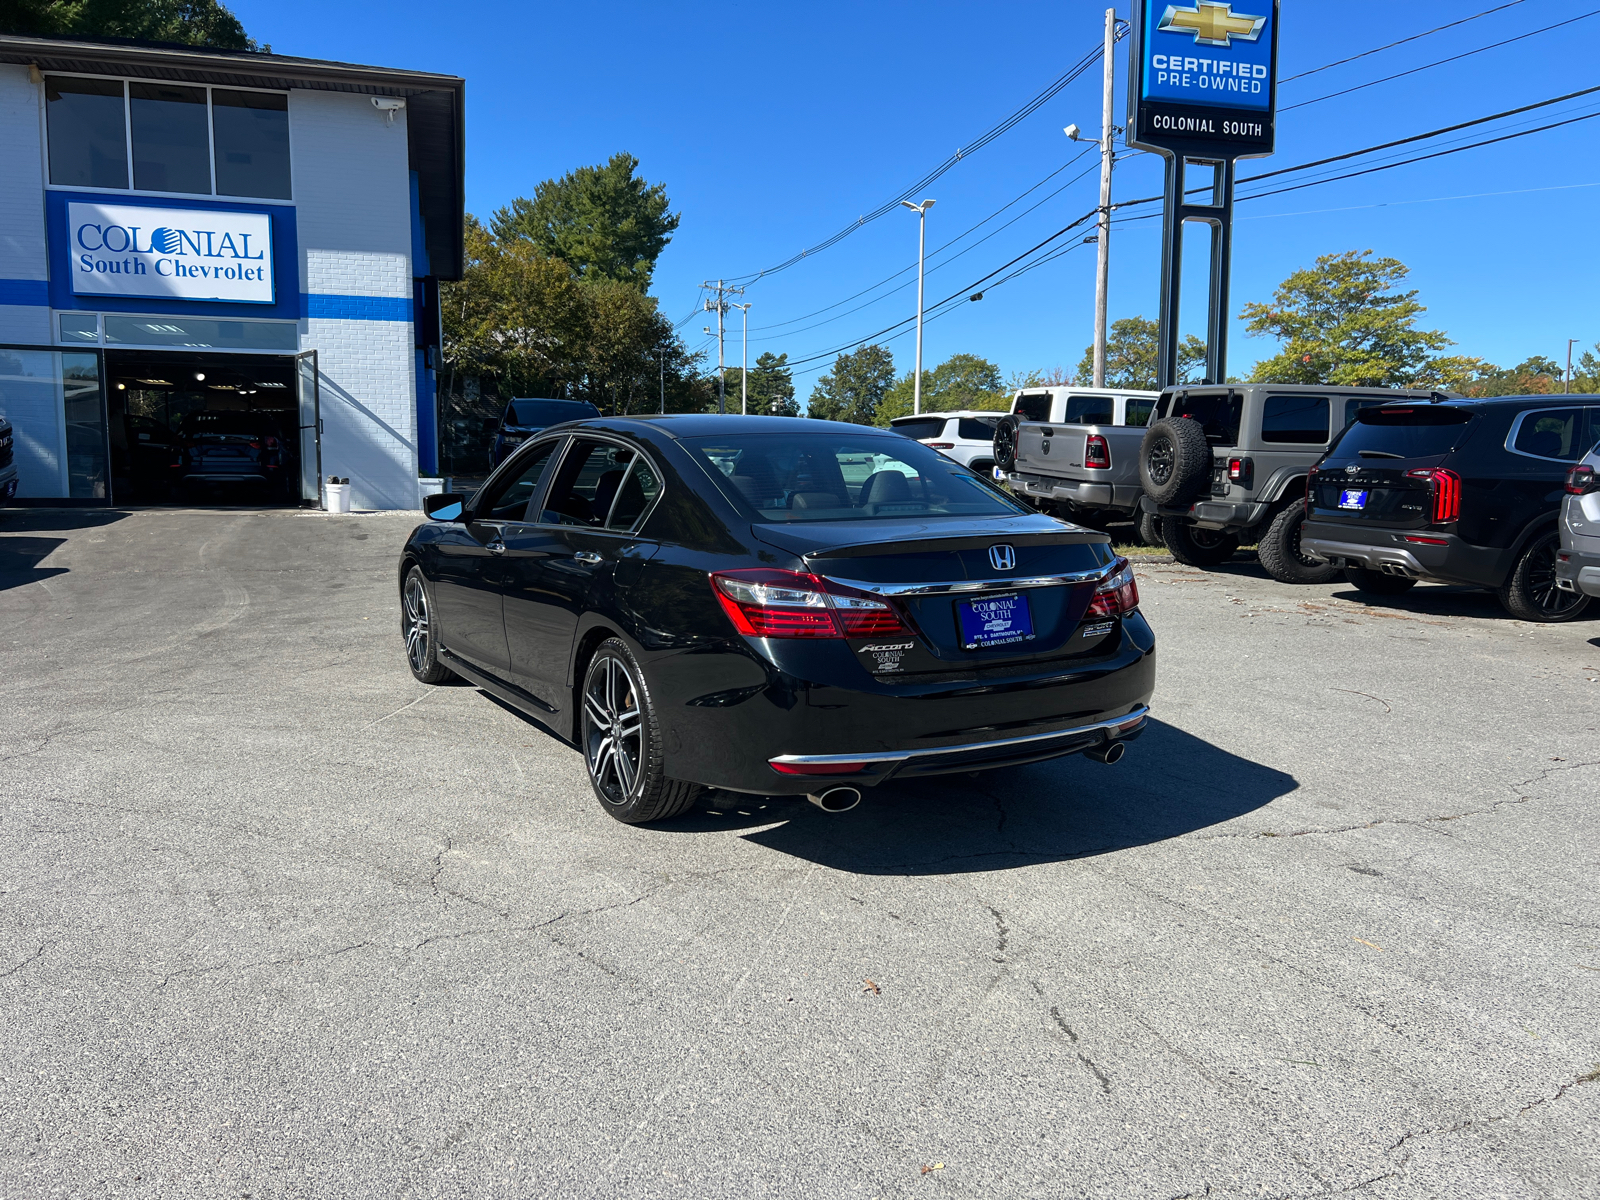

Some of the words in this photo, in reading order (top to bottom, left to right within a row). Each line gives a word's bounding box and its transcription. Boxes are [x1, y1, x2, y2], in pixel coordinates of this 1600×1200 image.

[1152, 54, 1267, 79] CERTIFIED
[1157, 71, 1261, 94] PRE-OWNED
[1153, 115, 1216, 133] COLONIAL
[1222, 121, 1262, 136] SOUTH
[77, 223, 264, 260] COLONIAL
[80, 254, 147, 275] South
[154, 258, 265, 282] Chevrolet
[972, 600, 1016, 612] COLONIAL
[980, 610, 1011, 621] SOUTH
[986, 621, 1010, 629] CHEVROLET
[858, 641, 914, 653] Accord
[981, 638, 1006, 647] COLONIAL
[1006, 635, 1023, 643] SOUTH
[872, 651, 905, 659] COLONIAL
[877, 656, 900, 664] SOUTH
